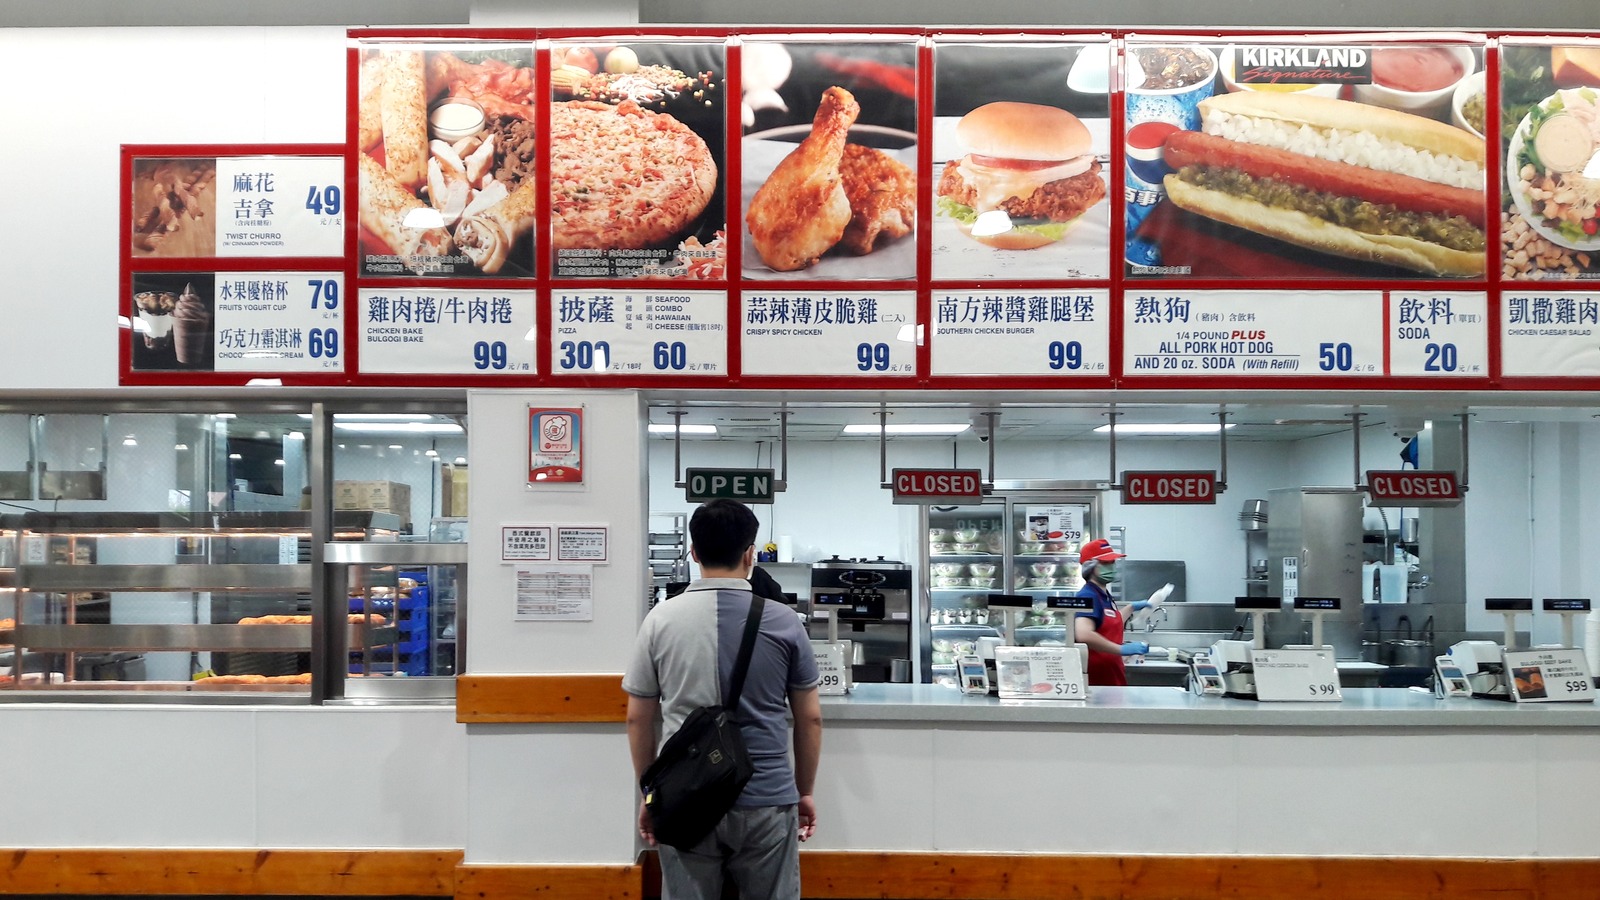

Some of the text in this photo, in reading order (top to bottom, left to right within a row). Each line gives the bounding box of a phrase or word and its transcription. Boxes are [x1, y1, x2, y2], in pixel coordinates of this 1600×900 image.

[1243, 47, 1367, 67] KIRKLAND
[1243, 66, 1367, 84] Signature
[233, 173, 274, 192] 麻花
[234, 199, 274, 218] 吉拿
[306, 186, 340, 215] 49
[220, 281, 288, 300] 水果優格杯
[308, 280, 338, 309] 79
[368, 296, 512, 323] 雞肉捲/牛肉捲
[559, 296, 614, 323] 披薩
[747, 297, 877, 324] 蒜辣薄皮脆雞
[938, 296, 1094, 323] 南方辣醬雞腿堡
[1135, 297, 1190, 323] 熱狗
[1229, 313, 1255, 321] 含飲料
[1399, 298, 1454, 324] 飲料
[1509, 298, 1598, 324] 凱撒雞肉
[220, 328, 302, 348] 巧克力霜淇淋
[937, 327, 973, 335] SOUTHERN
[1193, 332, 1229, 340] POUND
[1231, 331, 1265, 340] PLUS
[1399, 327, 1430, 339] SODA
[309, 328, 338, 358] 69
[1159, 342, 1273, 353] ALL PORK HOT DOG
[474, 341, 507, 369] 99
[560, 341, 610, 369] 300
[654, 342, 686, 370] 60
[857, 343, 889, 371] 99
[1049, 341, 1082, 369] 99
[1135, 357, 1299, 371] AND 20 oz. SODA (With Refill)
[1319, 343, 1352, 371] 50
[1424, 343, 1457, 372] 20
[691, 475, 769, 495] OPEN
[898, 475, 976, 493] CLOSED
[1129, 478, 1210, 499] CLOSED
[1373, 477, 1452, 496] CLOSED
[1064, 530, 1081, 540] $79
[1055, 682, 1079, 696] $79
[1320, 684, 1335, 695] 99
[1565, 680, 1588, 693] $99
